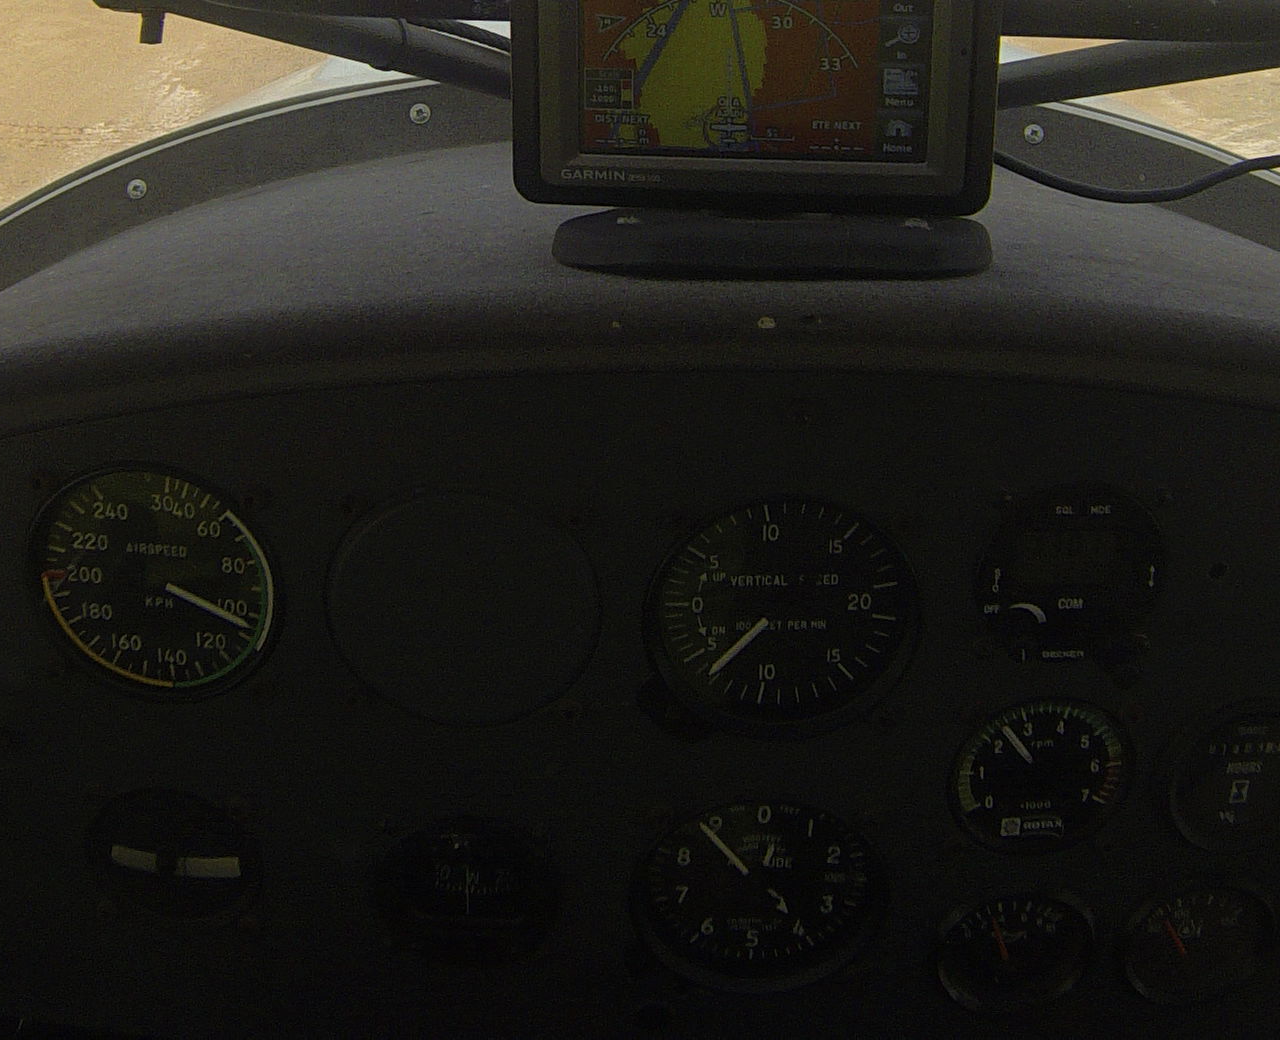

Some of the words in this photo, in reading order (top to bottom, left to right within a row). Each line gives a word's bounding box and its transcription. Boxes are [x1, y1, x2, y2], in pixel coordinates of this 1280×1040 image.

[710, 3, 726, 16] W
[893, 3, 914, 13] Out
[771, 16, 793, 29] 30
[647, 24, 667, 37] 24
[820, 58, 841, 71] 33
[595, 114, 619, 123] DIST
[622, 114, 650, 124] NEXT
[834, 121, 863, 131] NEXT
[882, 144, 913, 154] Home
[560, 168, 626, 181] GARMIN
[92, 501, 128, 521] 240
[196, 521, 222, 538] 60
[762, 523, 780, 541] 10
[71, 531, 108, 552] 220
[828, 539, 843, 554] 15
[221, 557, 245, 574] 80
[710, 554, 719, 569] 5
[67, 565, 103, 584] 200
[730, 574, 789, 587] VERTICAL
[692, 597, 703, 613] 0
[847, 592, 872, 611] 20
[1057, 598, 1084, 610] COM
[80, 602, 113, 621] 180
[110, 632, 142, 651] 160
[195, 631, 226, 649] 120
[707, 637, 717, 650] 5
[157, 648, 187, 666] 140
[826, 648, 840, 662] 15
[758, 664, 776, 680] 10
[1022, 722, 1033, 737] 3
[1056, 720, 1065, 735] 4
[993, 739, 1004, 754] 2
[1031, 739, 1055, 750] rpm
[1080, 734, 1090, 749] 5
[979, 765, 985, 780] 1
[1090, 758, 1100, 773] 6
[984, 794, 994, 810] 0
[1081, 789, 1090, 803] 7
[757, 805, 772, 824] 0
[807, 818, 814, 838] 1
[677, 847, 691, 866] 8
[826, 845, 841, 865] 2
[675, 885, 689, 904] 7
[820, 894, 833, 914] 3
[700, 917, 714, 935] 6
[745, 930, 760, 948] 5
